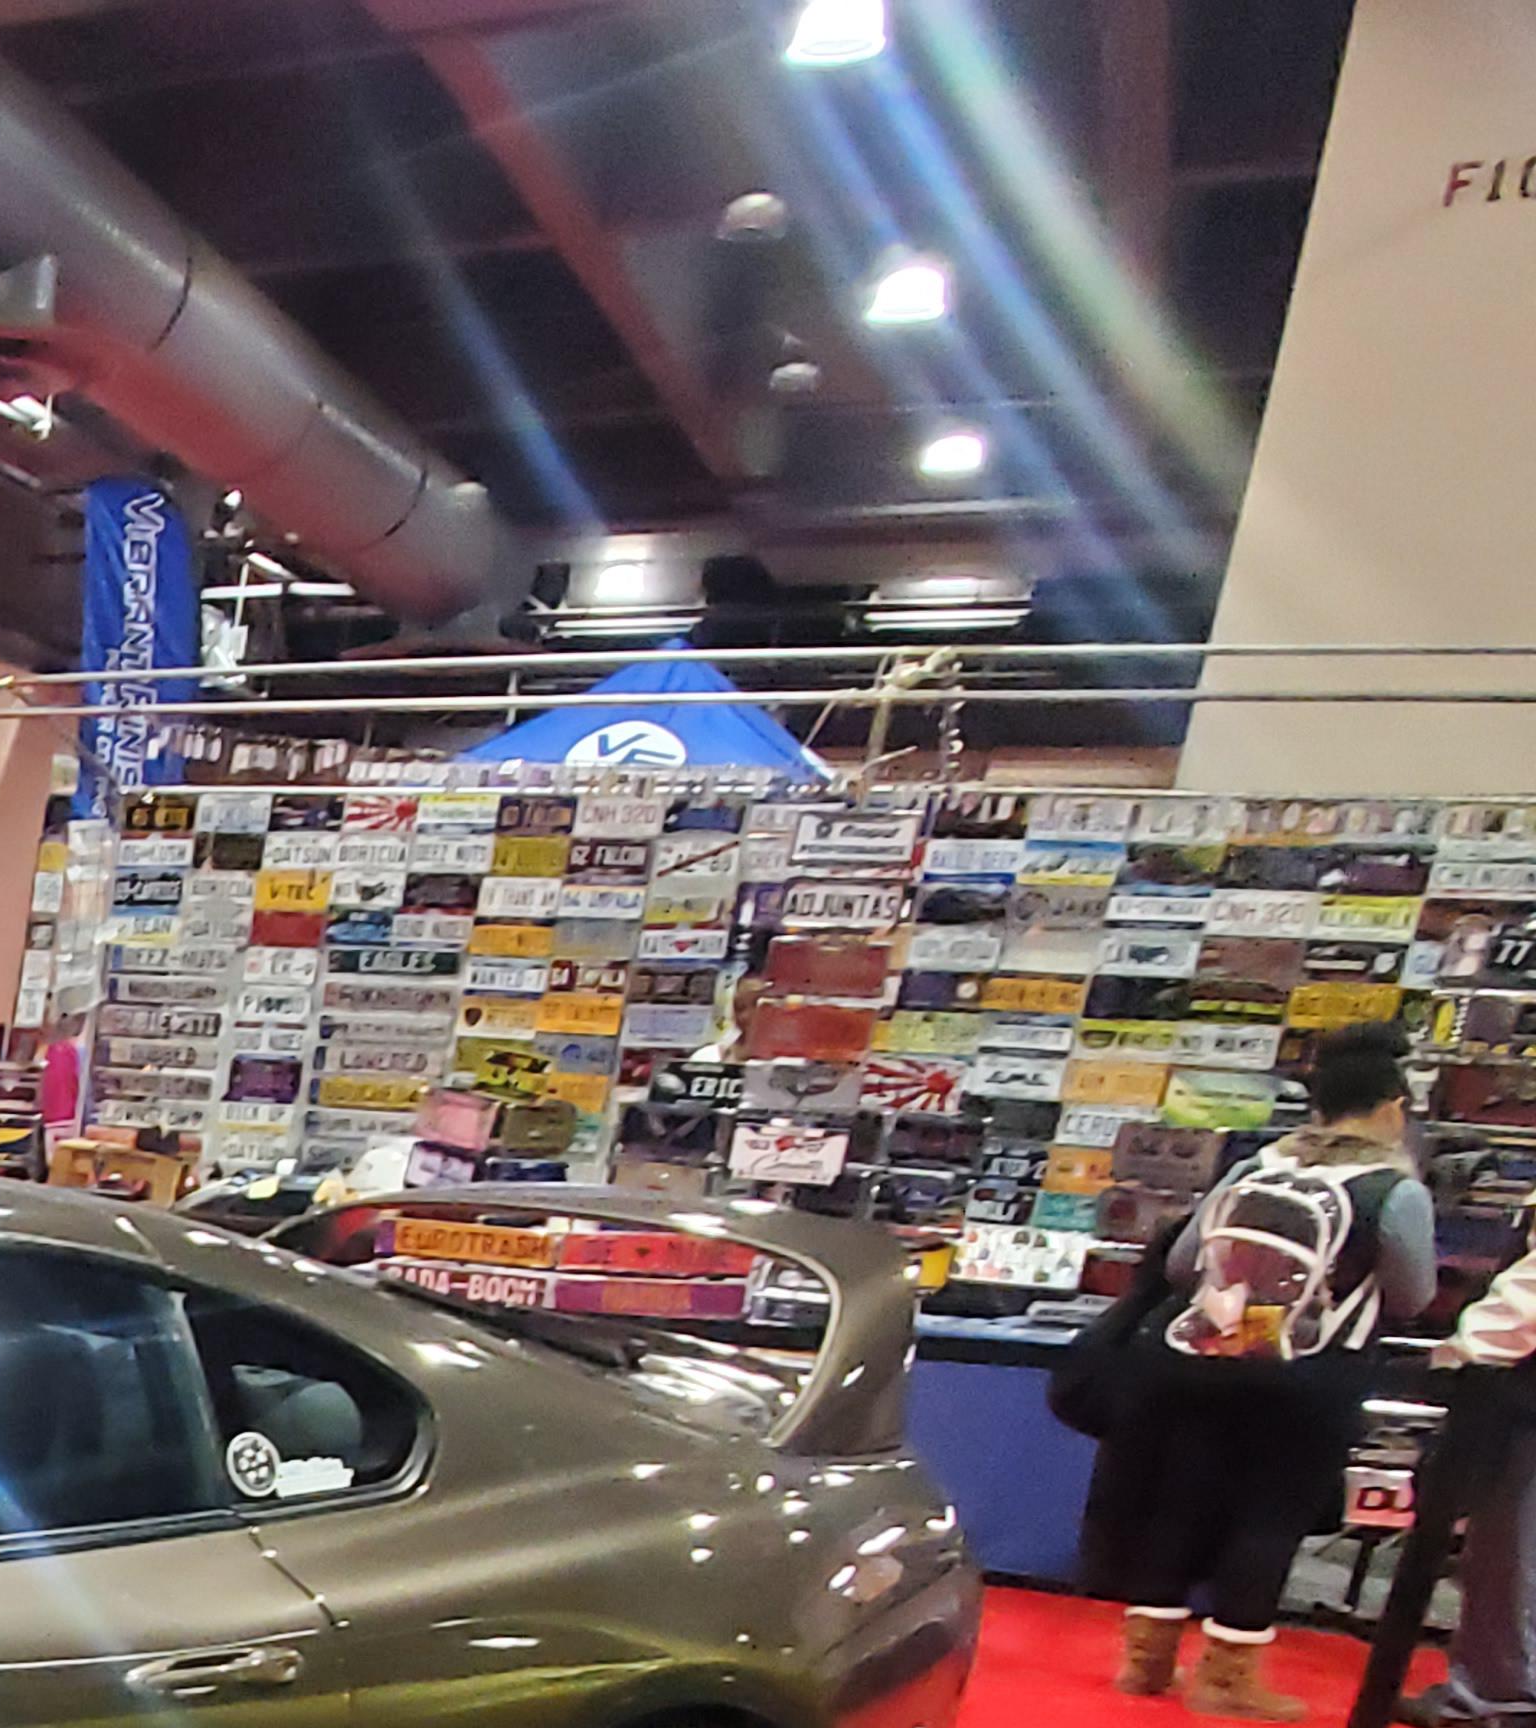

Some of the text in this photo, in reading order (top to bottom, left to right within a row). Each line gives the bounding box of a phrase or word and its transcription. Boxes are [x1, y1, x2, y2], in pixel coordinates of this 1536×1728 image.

[621, 804, 656, 824] 320
[359, 951, 436, 972] EAGLES
[690, 1076, 744, 1099] ERIC
[400, 1225, 551, 1259] EUROTRASH
